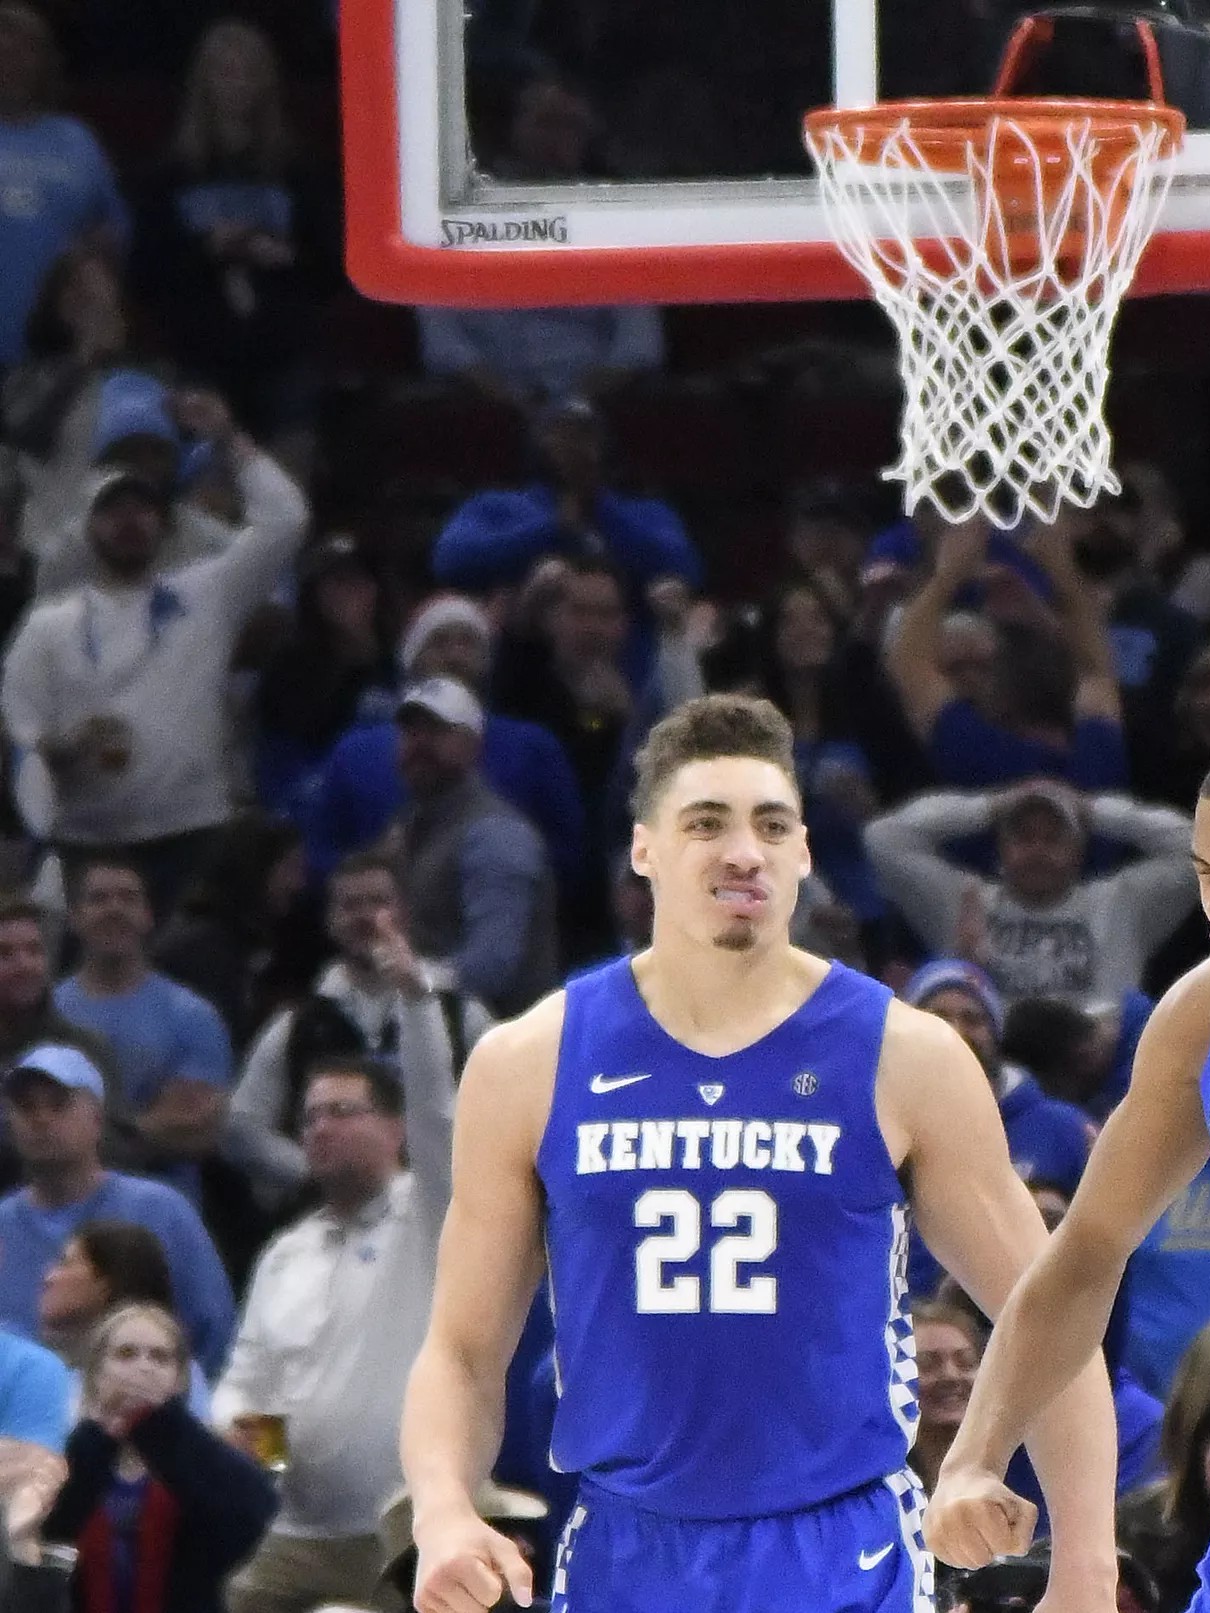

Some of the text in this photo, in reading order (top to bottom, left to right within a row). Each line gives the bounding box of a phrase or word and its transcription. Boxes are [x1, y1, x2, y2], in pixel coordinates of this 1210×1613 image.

[441, 216, 569, 248] SPALDING
[576, 1120, 841, 1175] KENTUCKY
[634, 1189, 777, 1315] 22
